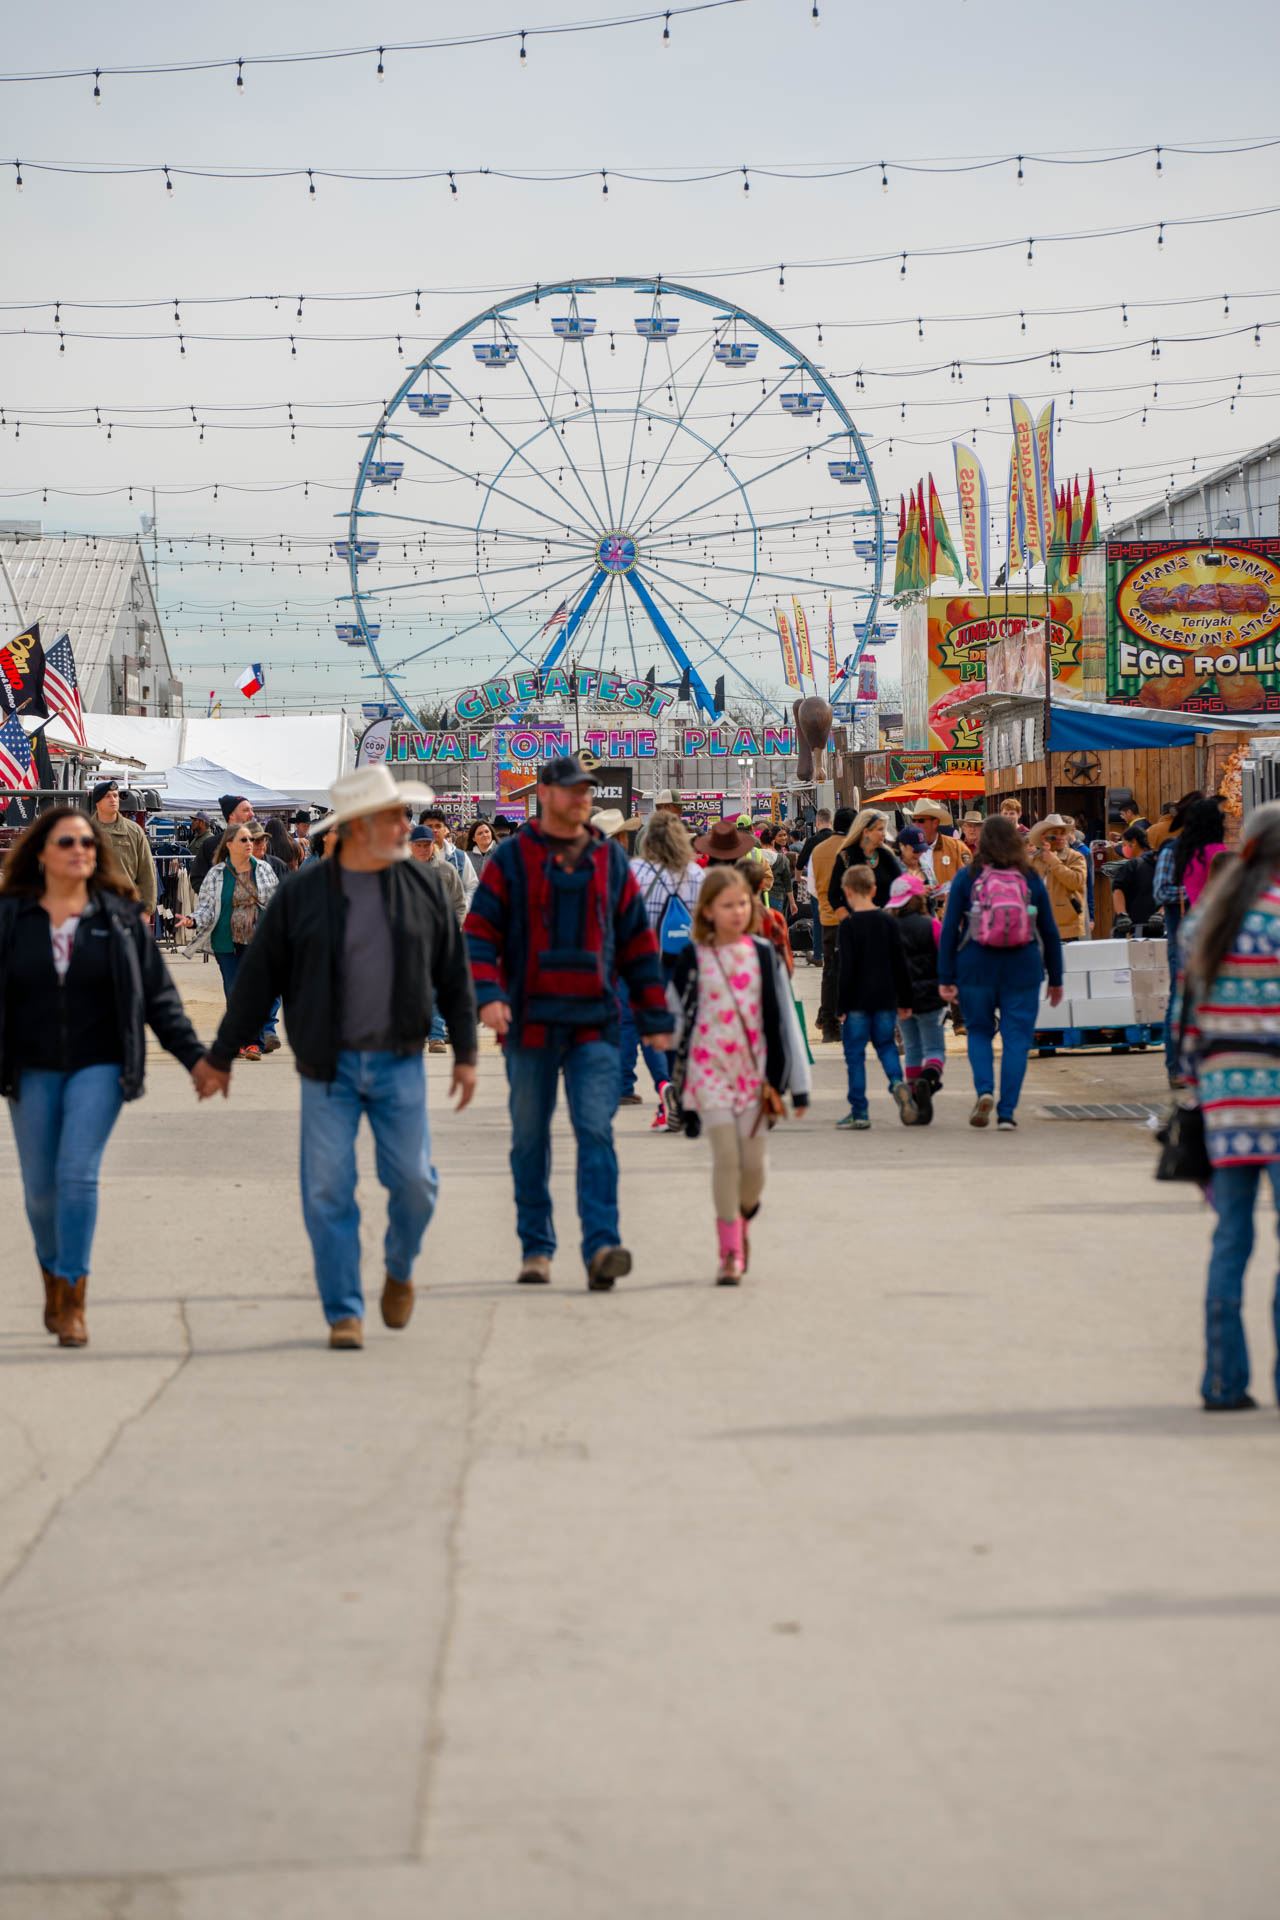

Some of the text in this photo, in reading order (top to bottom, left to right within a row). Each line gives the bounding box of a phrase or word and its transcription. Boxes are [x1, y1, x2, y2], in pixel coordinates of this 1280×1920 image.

[1132, 553, 1275, 591] CHAN'S OIGINAL
[956, 620, 997, 648] JUMBO
[1129, 607, 1196, 644] CHICKEN
[1199, 631, 1222, 645] ON
[1224, 630, 1237, 643] A
[1181, 616, 1233, 629] Teriyaki
[1120, 641, 1185, 678] EGG
[455, 668, 674, 719] GREATEST
[509, 731, 572, 759] ON
[584, 730, 658, 758] THE
[683, 728, 836, 757] PLAN
[697, 801, 721, 810] PASS
